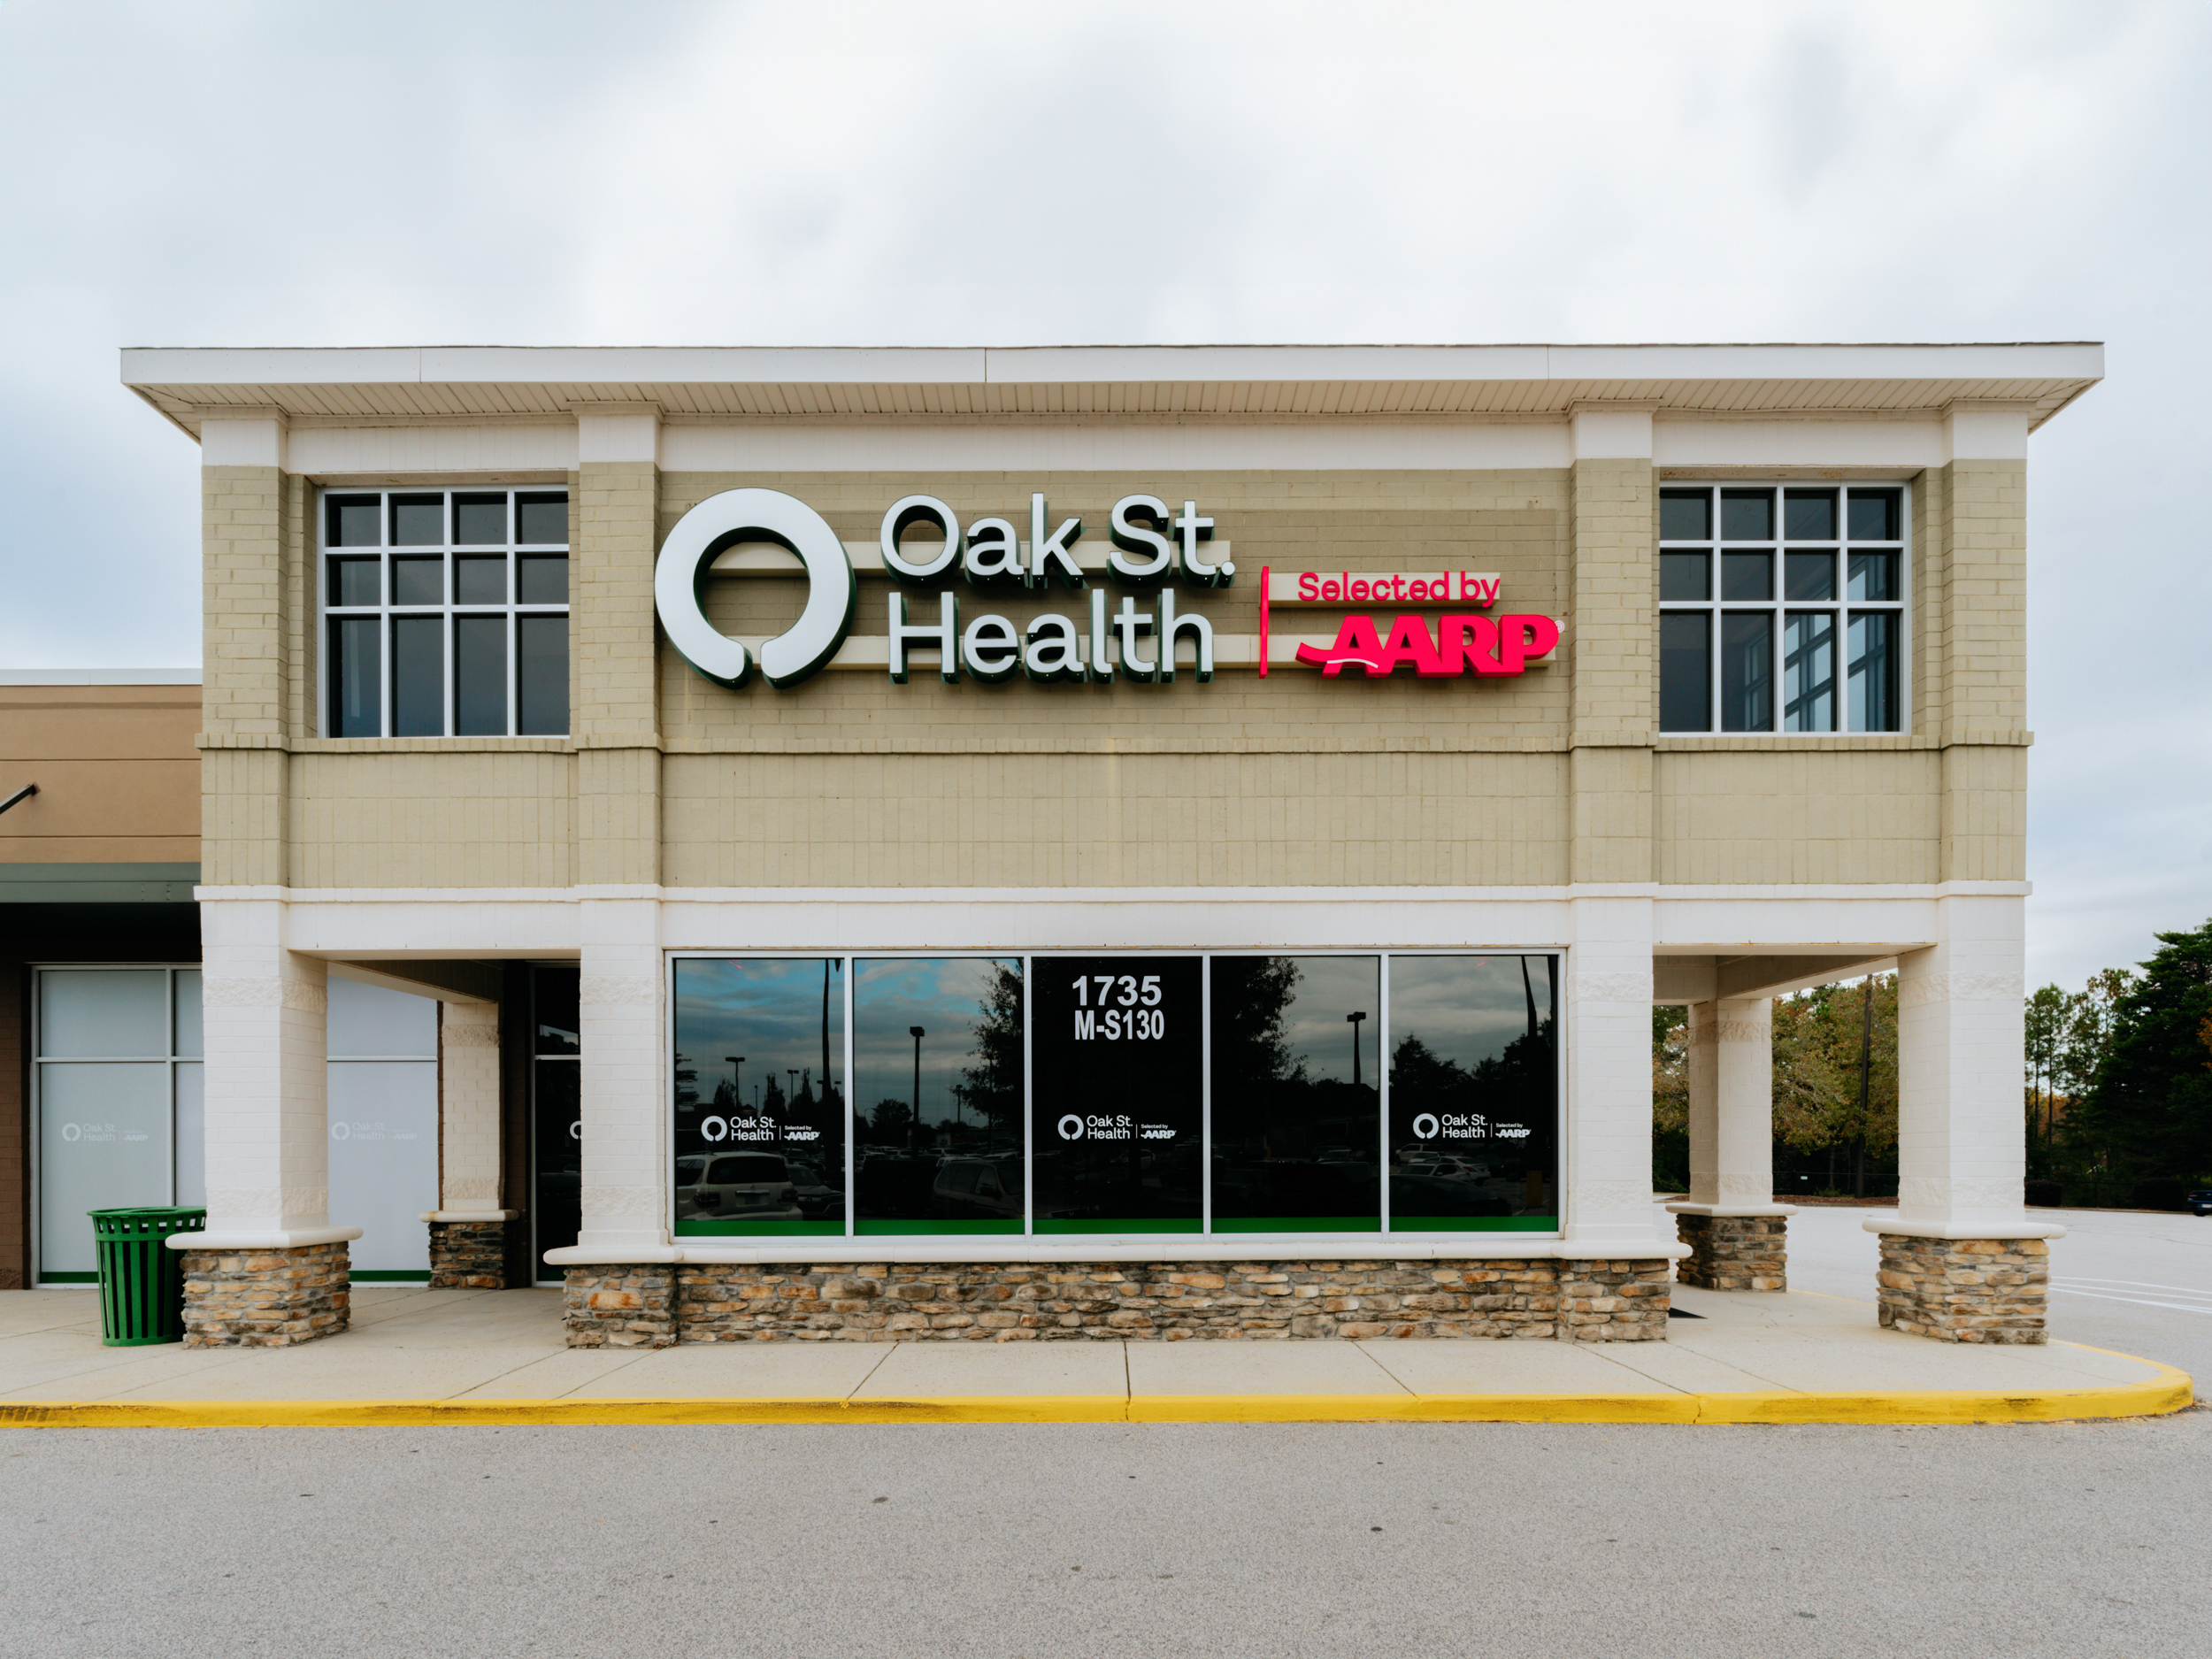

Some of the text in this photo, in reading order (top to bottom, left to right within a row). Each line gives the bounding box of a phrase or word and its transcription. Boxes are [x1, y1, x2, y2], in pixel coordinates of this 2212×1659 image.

[880, 492, 1236, 586] Oak St.
[1298, 571, 1501, 608] Selected by
[888, 588, 1214, 682] Health
[1072, 975, 1162, 1006] 1735
[1075, 1010, 1164, 1041] M-S130
[730, 1116, 777, 1128] Oak St.
[1087, 1115, 1133, 1127] Oak St.
[1441, 1114, 1488, 1126] Oak St.
[83, 1123, 103, 1133] Oak
[731, 1128, 774, 1141] Health
[1087, 1127, 1130, 1140] Health
[1442, 1125, 1486, 1138] Health
[83, 1133, 116, 1141] Health
